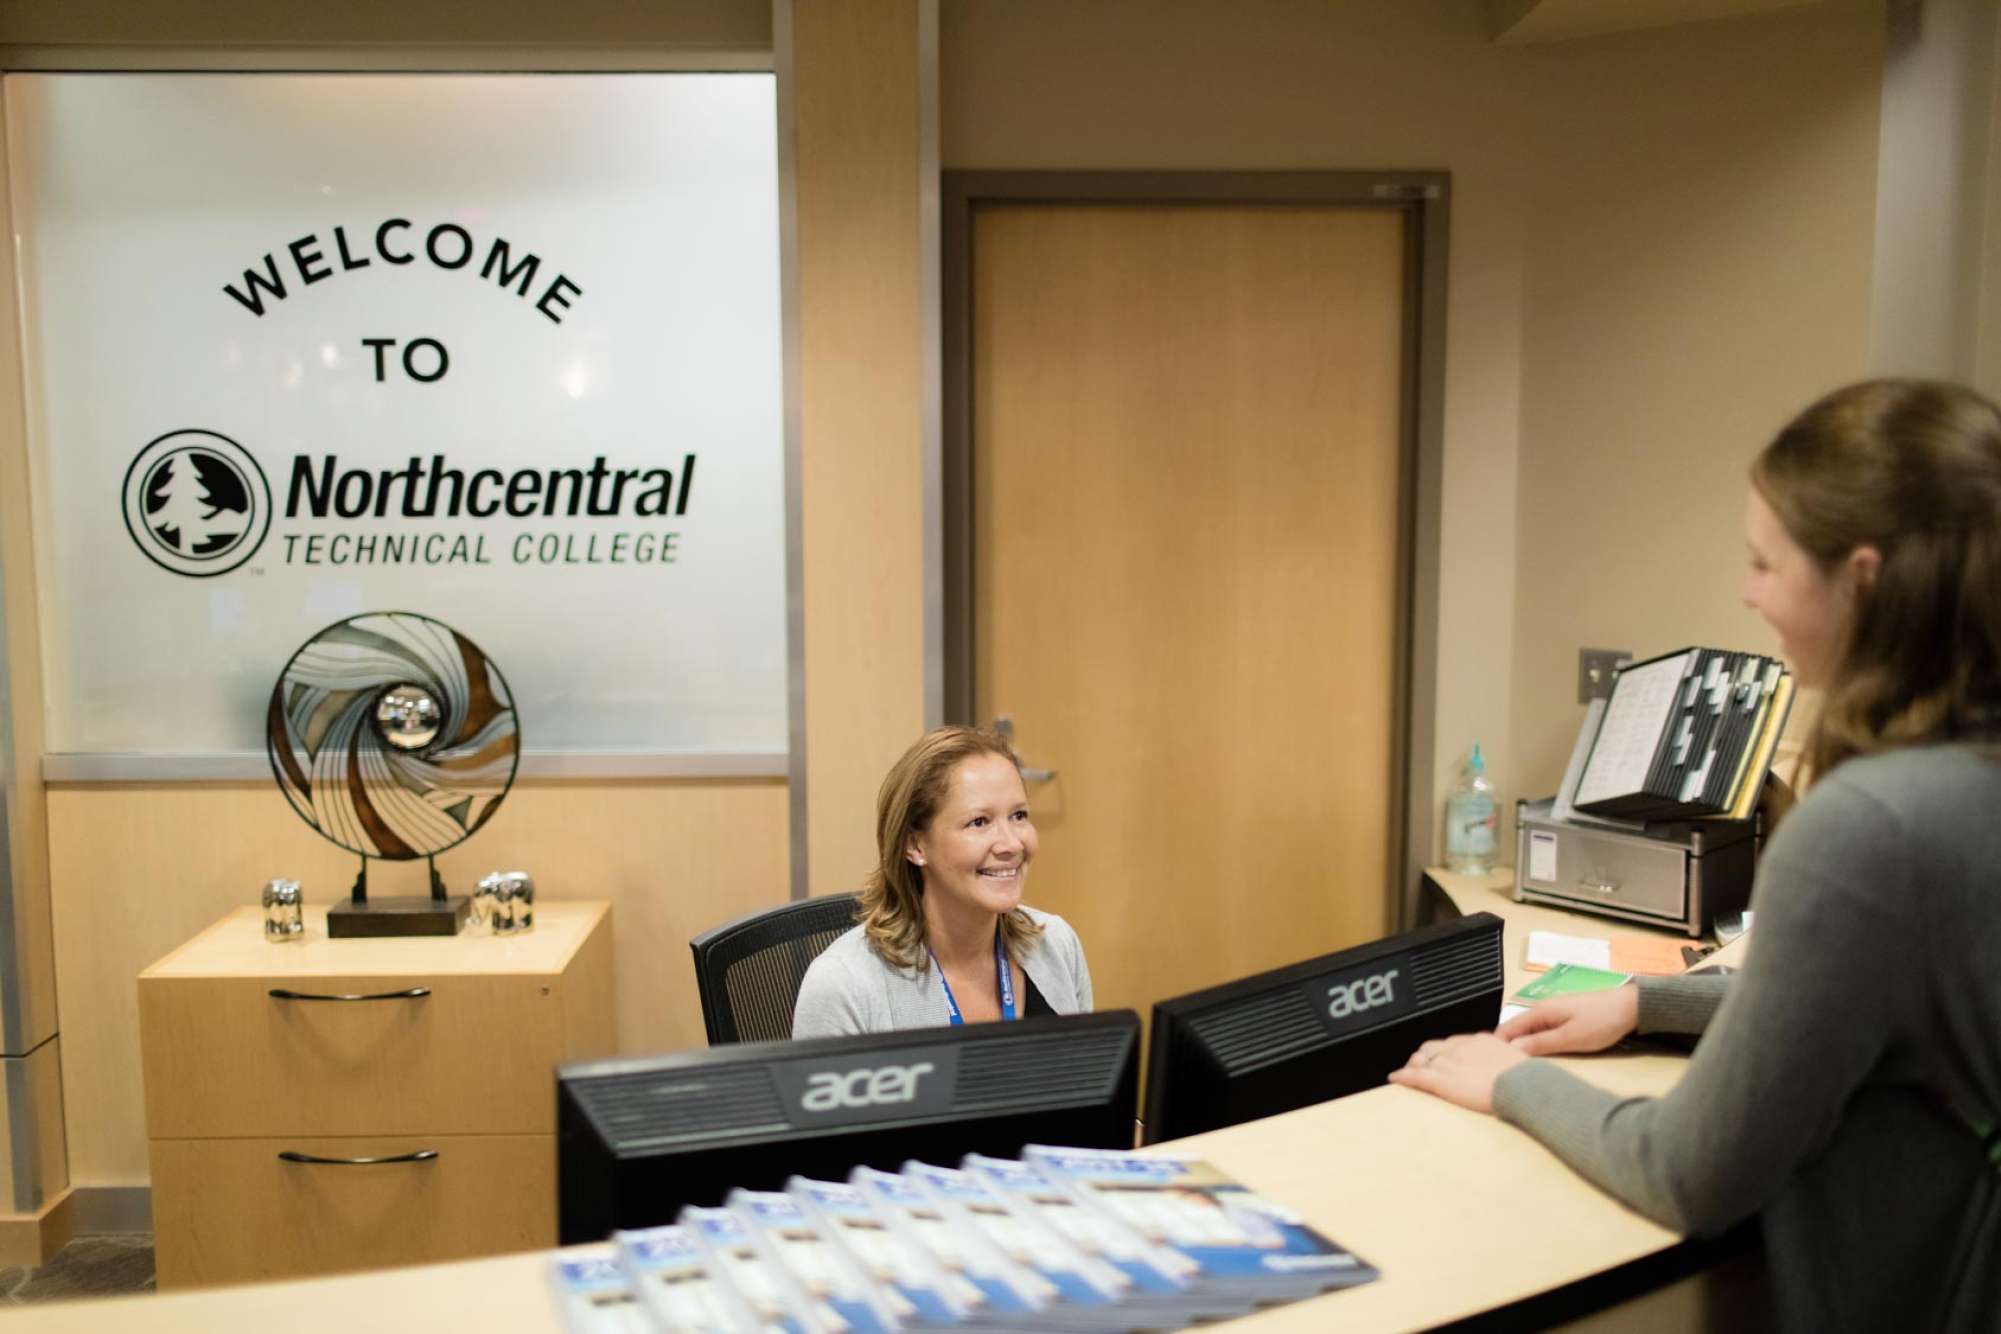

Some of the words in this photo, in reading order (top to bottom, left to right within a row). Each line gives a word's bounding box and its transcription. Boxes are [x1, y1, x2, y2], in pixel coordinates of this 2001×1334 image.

[222, 218, 583, 325] WELCOME
[361, 337, 450, 383] TO
[284, 454, 697, 520] Northcentral
[283, 533, 491, 565] TECHNICAL
[512, 532, 682, 564] COLLEGE
[1327, 968, 1400, 1019] acer
[800, 1061, 935, 1113] acer
